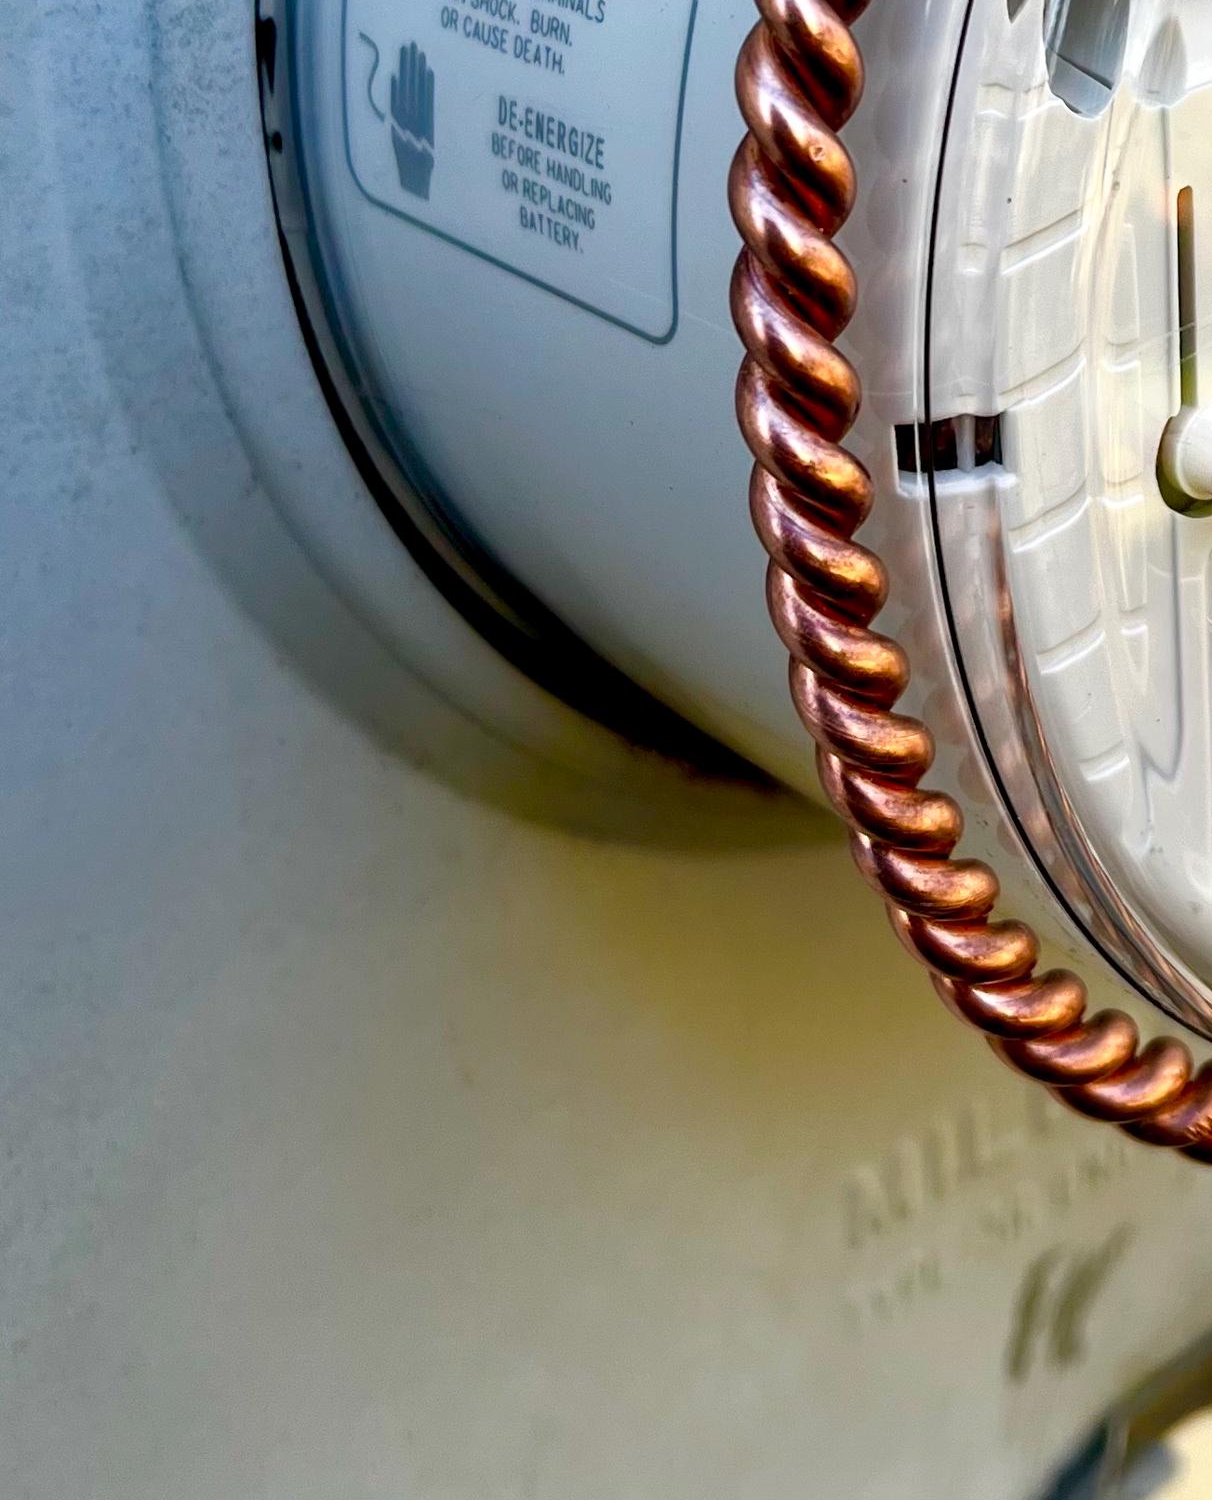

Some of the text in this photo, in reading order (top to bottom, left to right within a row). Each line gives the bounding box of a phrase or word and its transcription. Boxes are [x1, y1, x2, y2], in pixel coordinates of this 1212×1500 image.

[440, 5, 566, 76] OR CAUSE DEATH.
[497, 94, 606, 171] DE-ENERGIZE
[491, 131, 613, 206] BEFORE HANDLING
[501, 168, 596, 231] OR REPLACING
[519, 204, 584, 255] BATTERY.
